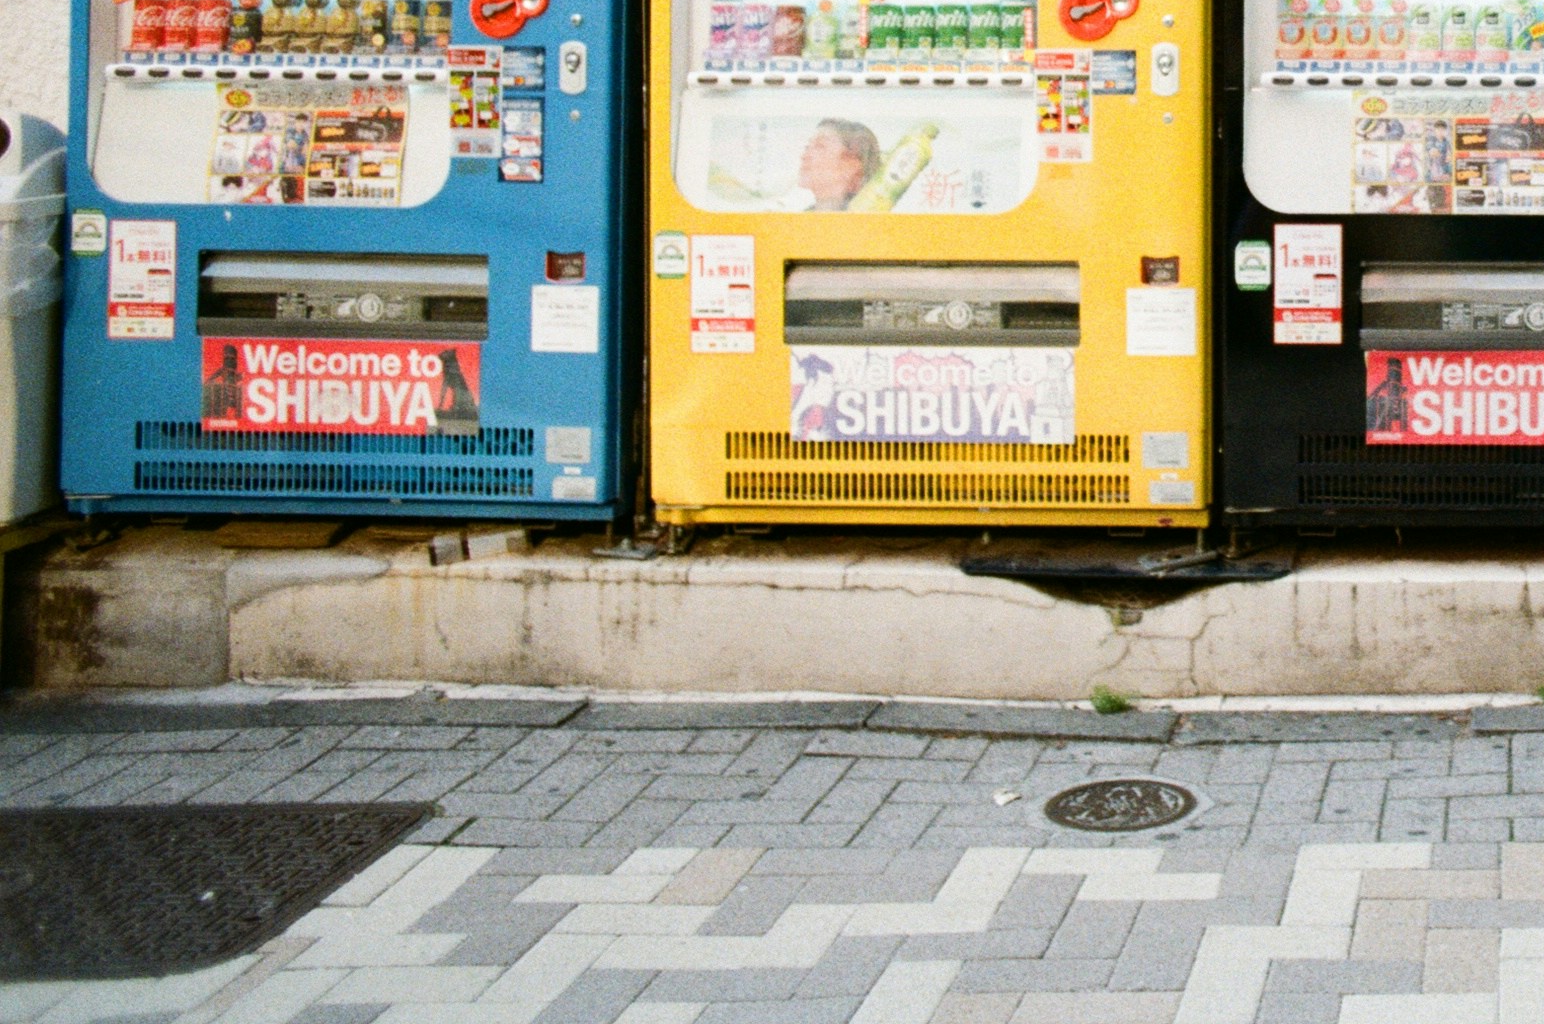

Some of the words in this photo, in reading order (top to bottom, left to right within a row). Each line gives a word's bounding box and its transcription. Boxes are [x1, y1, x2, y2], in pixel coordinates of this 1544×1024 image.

[921, 169, 964, 209] 新
[243, 343, 402, 376] Welcome
[408, 348, 443, 377] to
[836, 360, 994, 387] Welcome
[1003, 360, 1038, 387] to
[246, 378, 438, 426] SHIBUYA
[835, 389, 1032, 437] SHIBUYA
